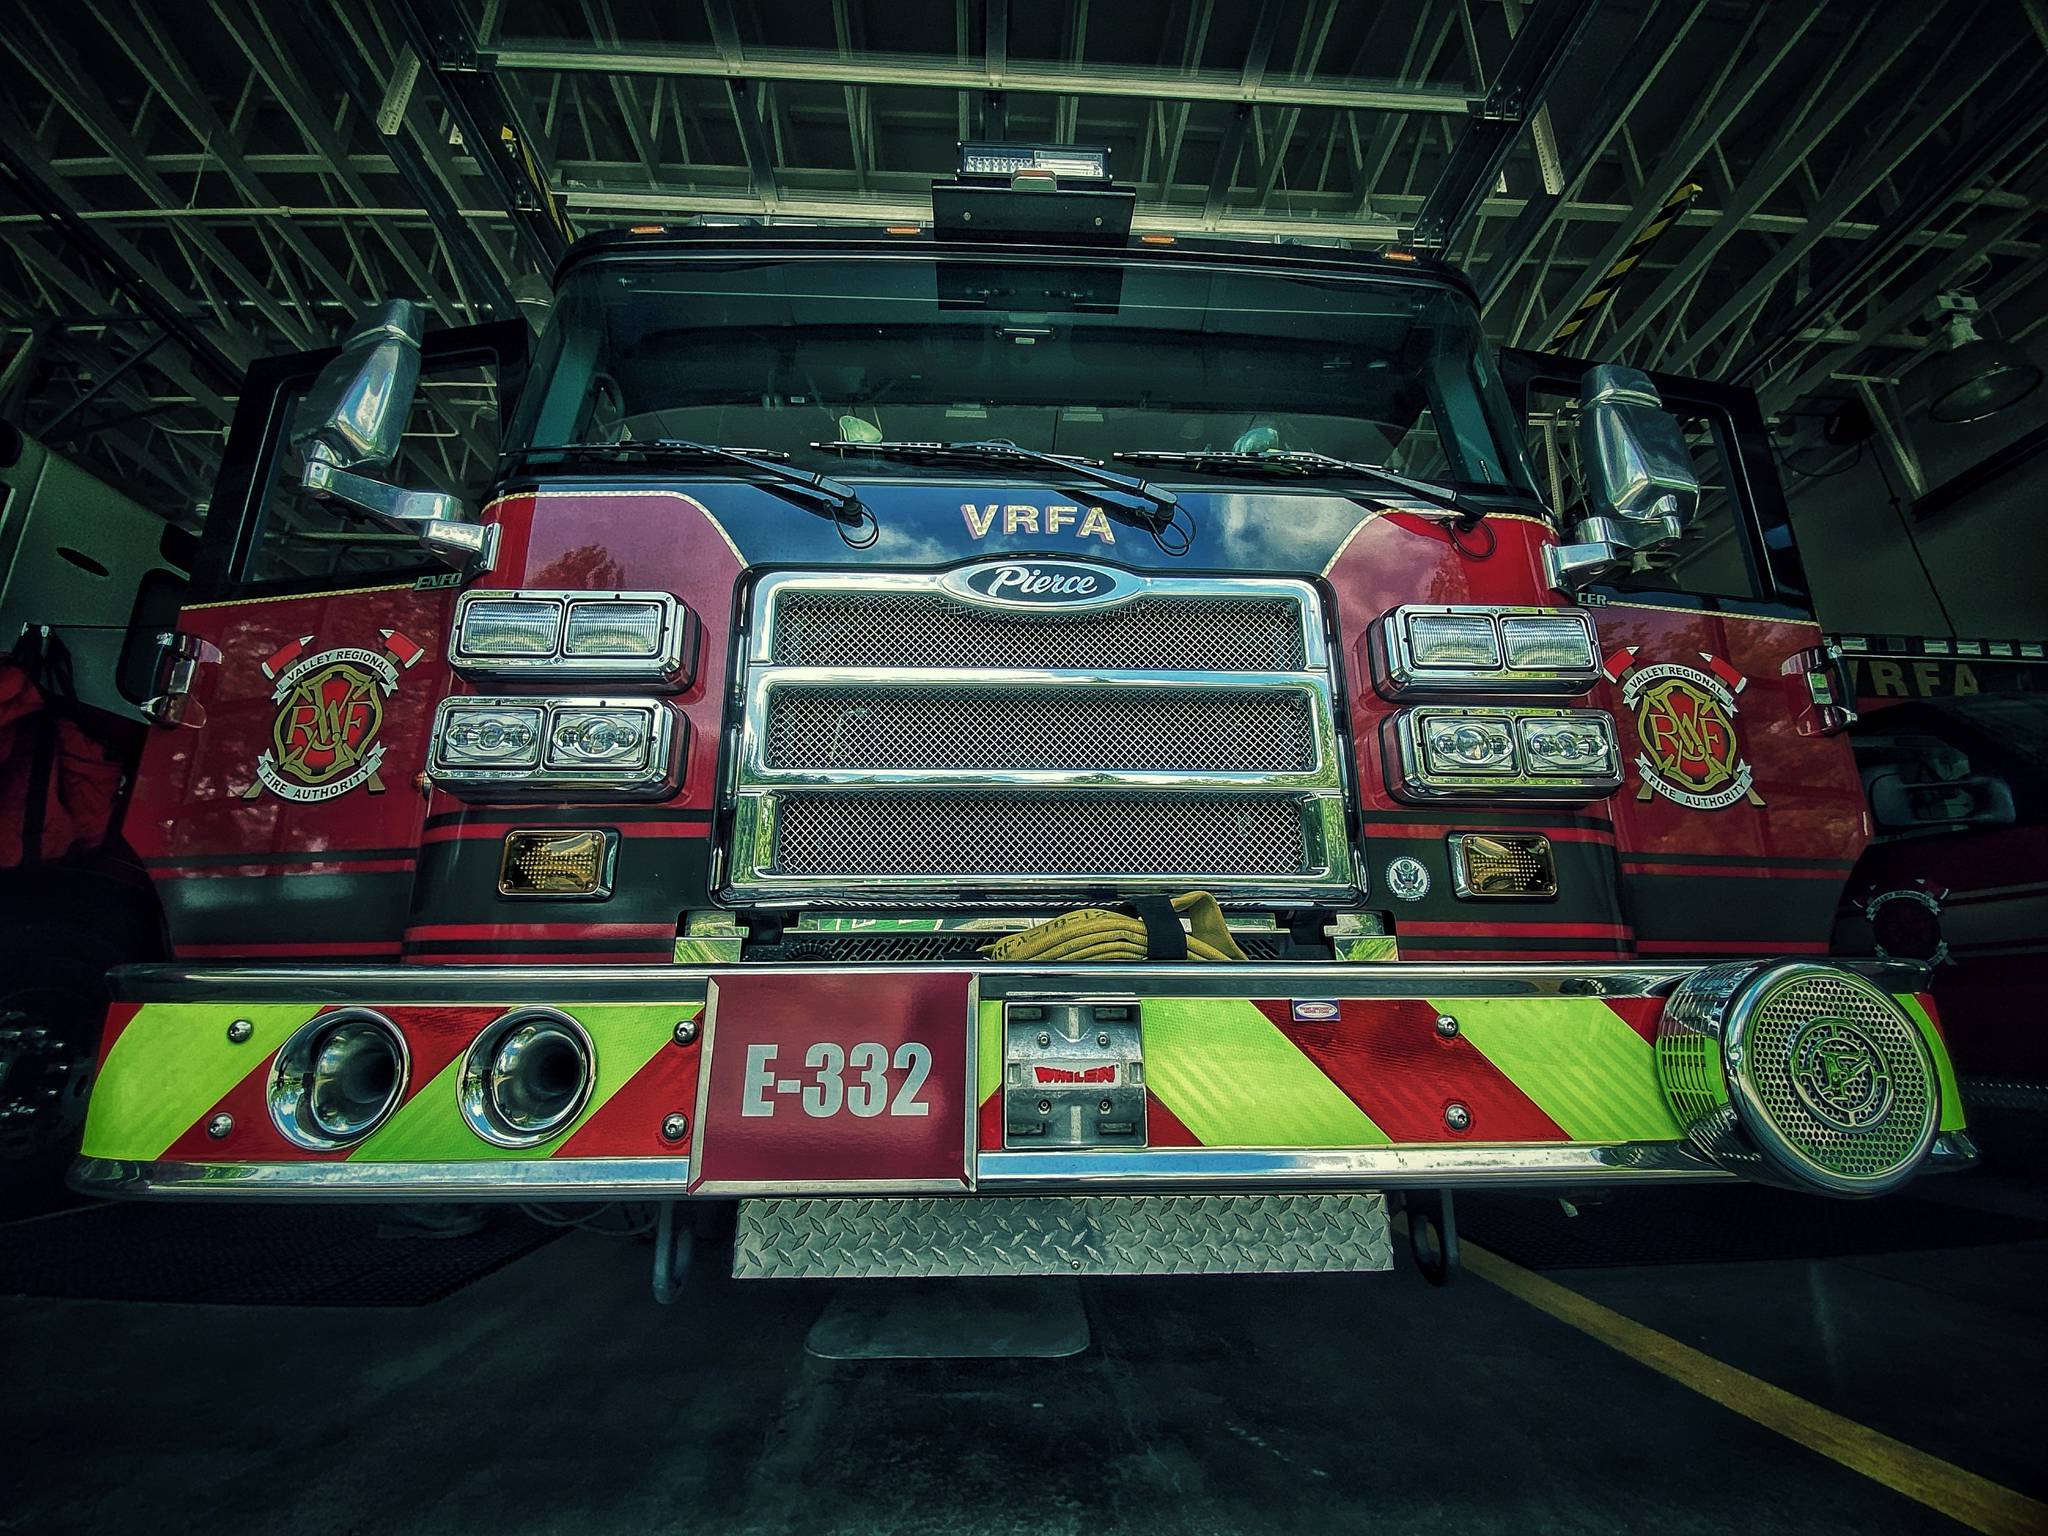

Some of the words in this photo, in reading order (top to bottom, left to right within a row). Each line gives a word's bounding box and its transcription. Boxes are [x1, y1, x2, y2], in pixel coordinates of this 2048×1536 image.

[960, 503, 1116, 545] VRFA
[987, 566, 1098, 597] Pierce
[287, 654, 332, 682] VALLEY
[336, 650, 389, 675] REGIONAL
[1629, 666, 1665, 689] VALLEY
[1669, 666, 1722, 695] REGIONAL
[263, 771, 287, 794] FIRE
[293, 766, 370, 799] AUTHORITY
[1649, 776, 1677, 799] FIRE
[1685, 782, 1746, 807] AUTHORITY
[741, 1042, 933, 1117] E-332
